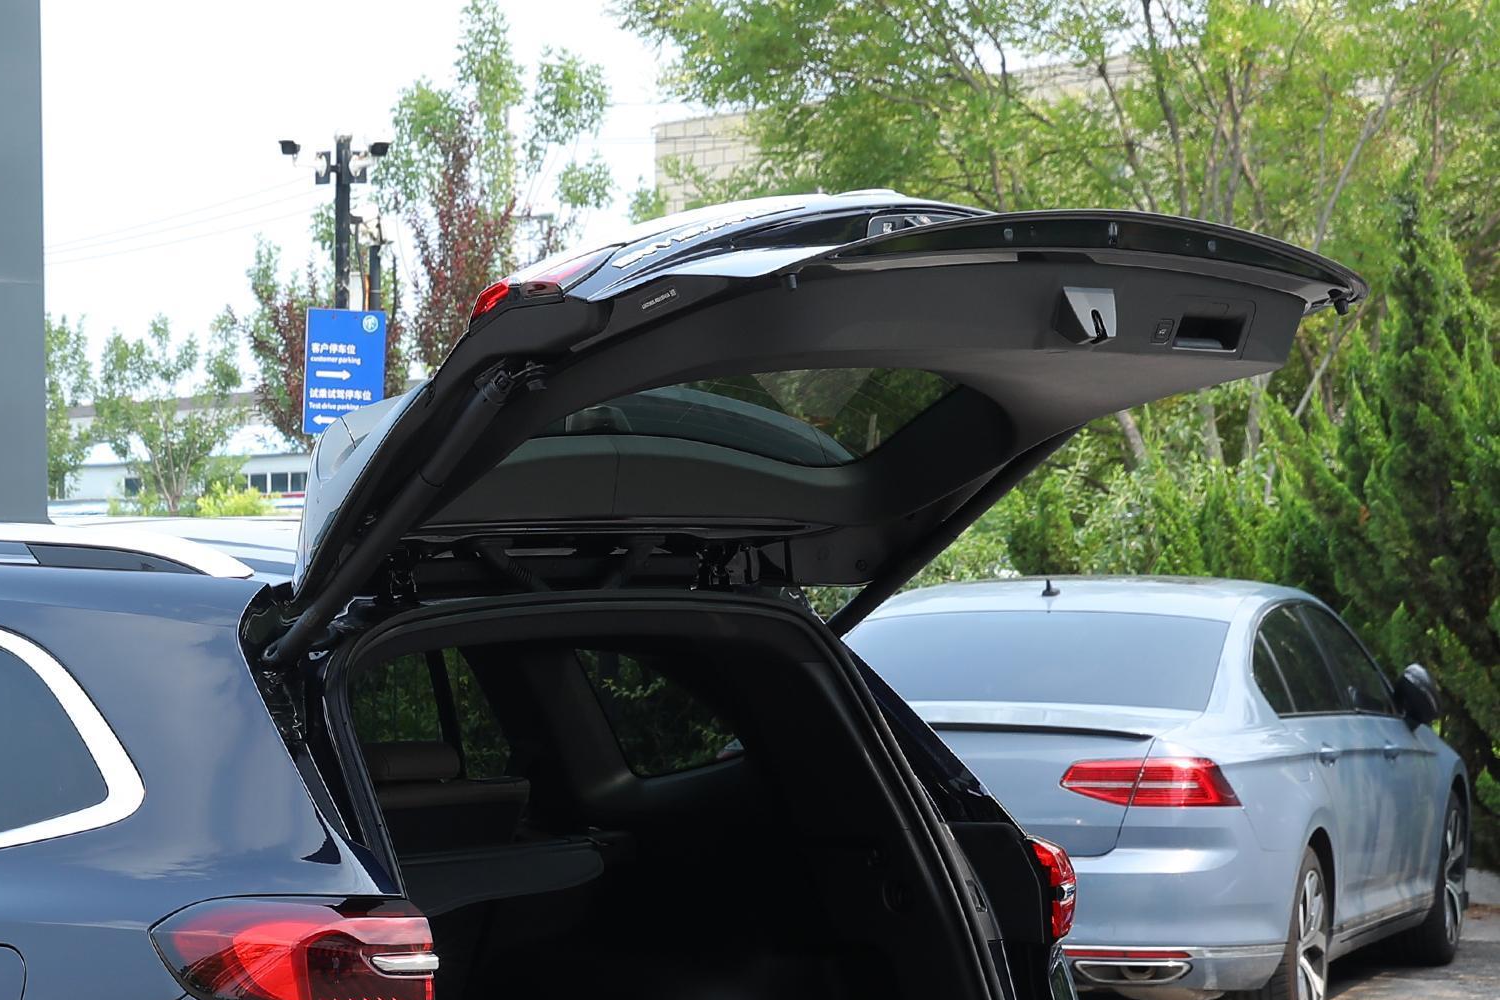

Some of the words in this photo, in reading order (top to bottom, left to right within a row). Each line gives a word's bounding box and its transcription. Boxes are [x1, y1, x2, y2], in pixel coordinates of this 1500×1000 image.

[311, 342, 356, 355] 客户停车位
[310, 355, 338, 363] customer
[338, 356, 361, 366] parking
[309, 387, 372, 401] 试乘试驾停车位
[308, 401, 321, 410] Test
[321, 402, 337, 410] drive
[337, 403, 359, 411] parking
